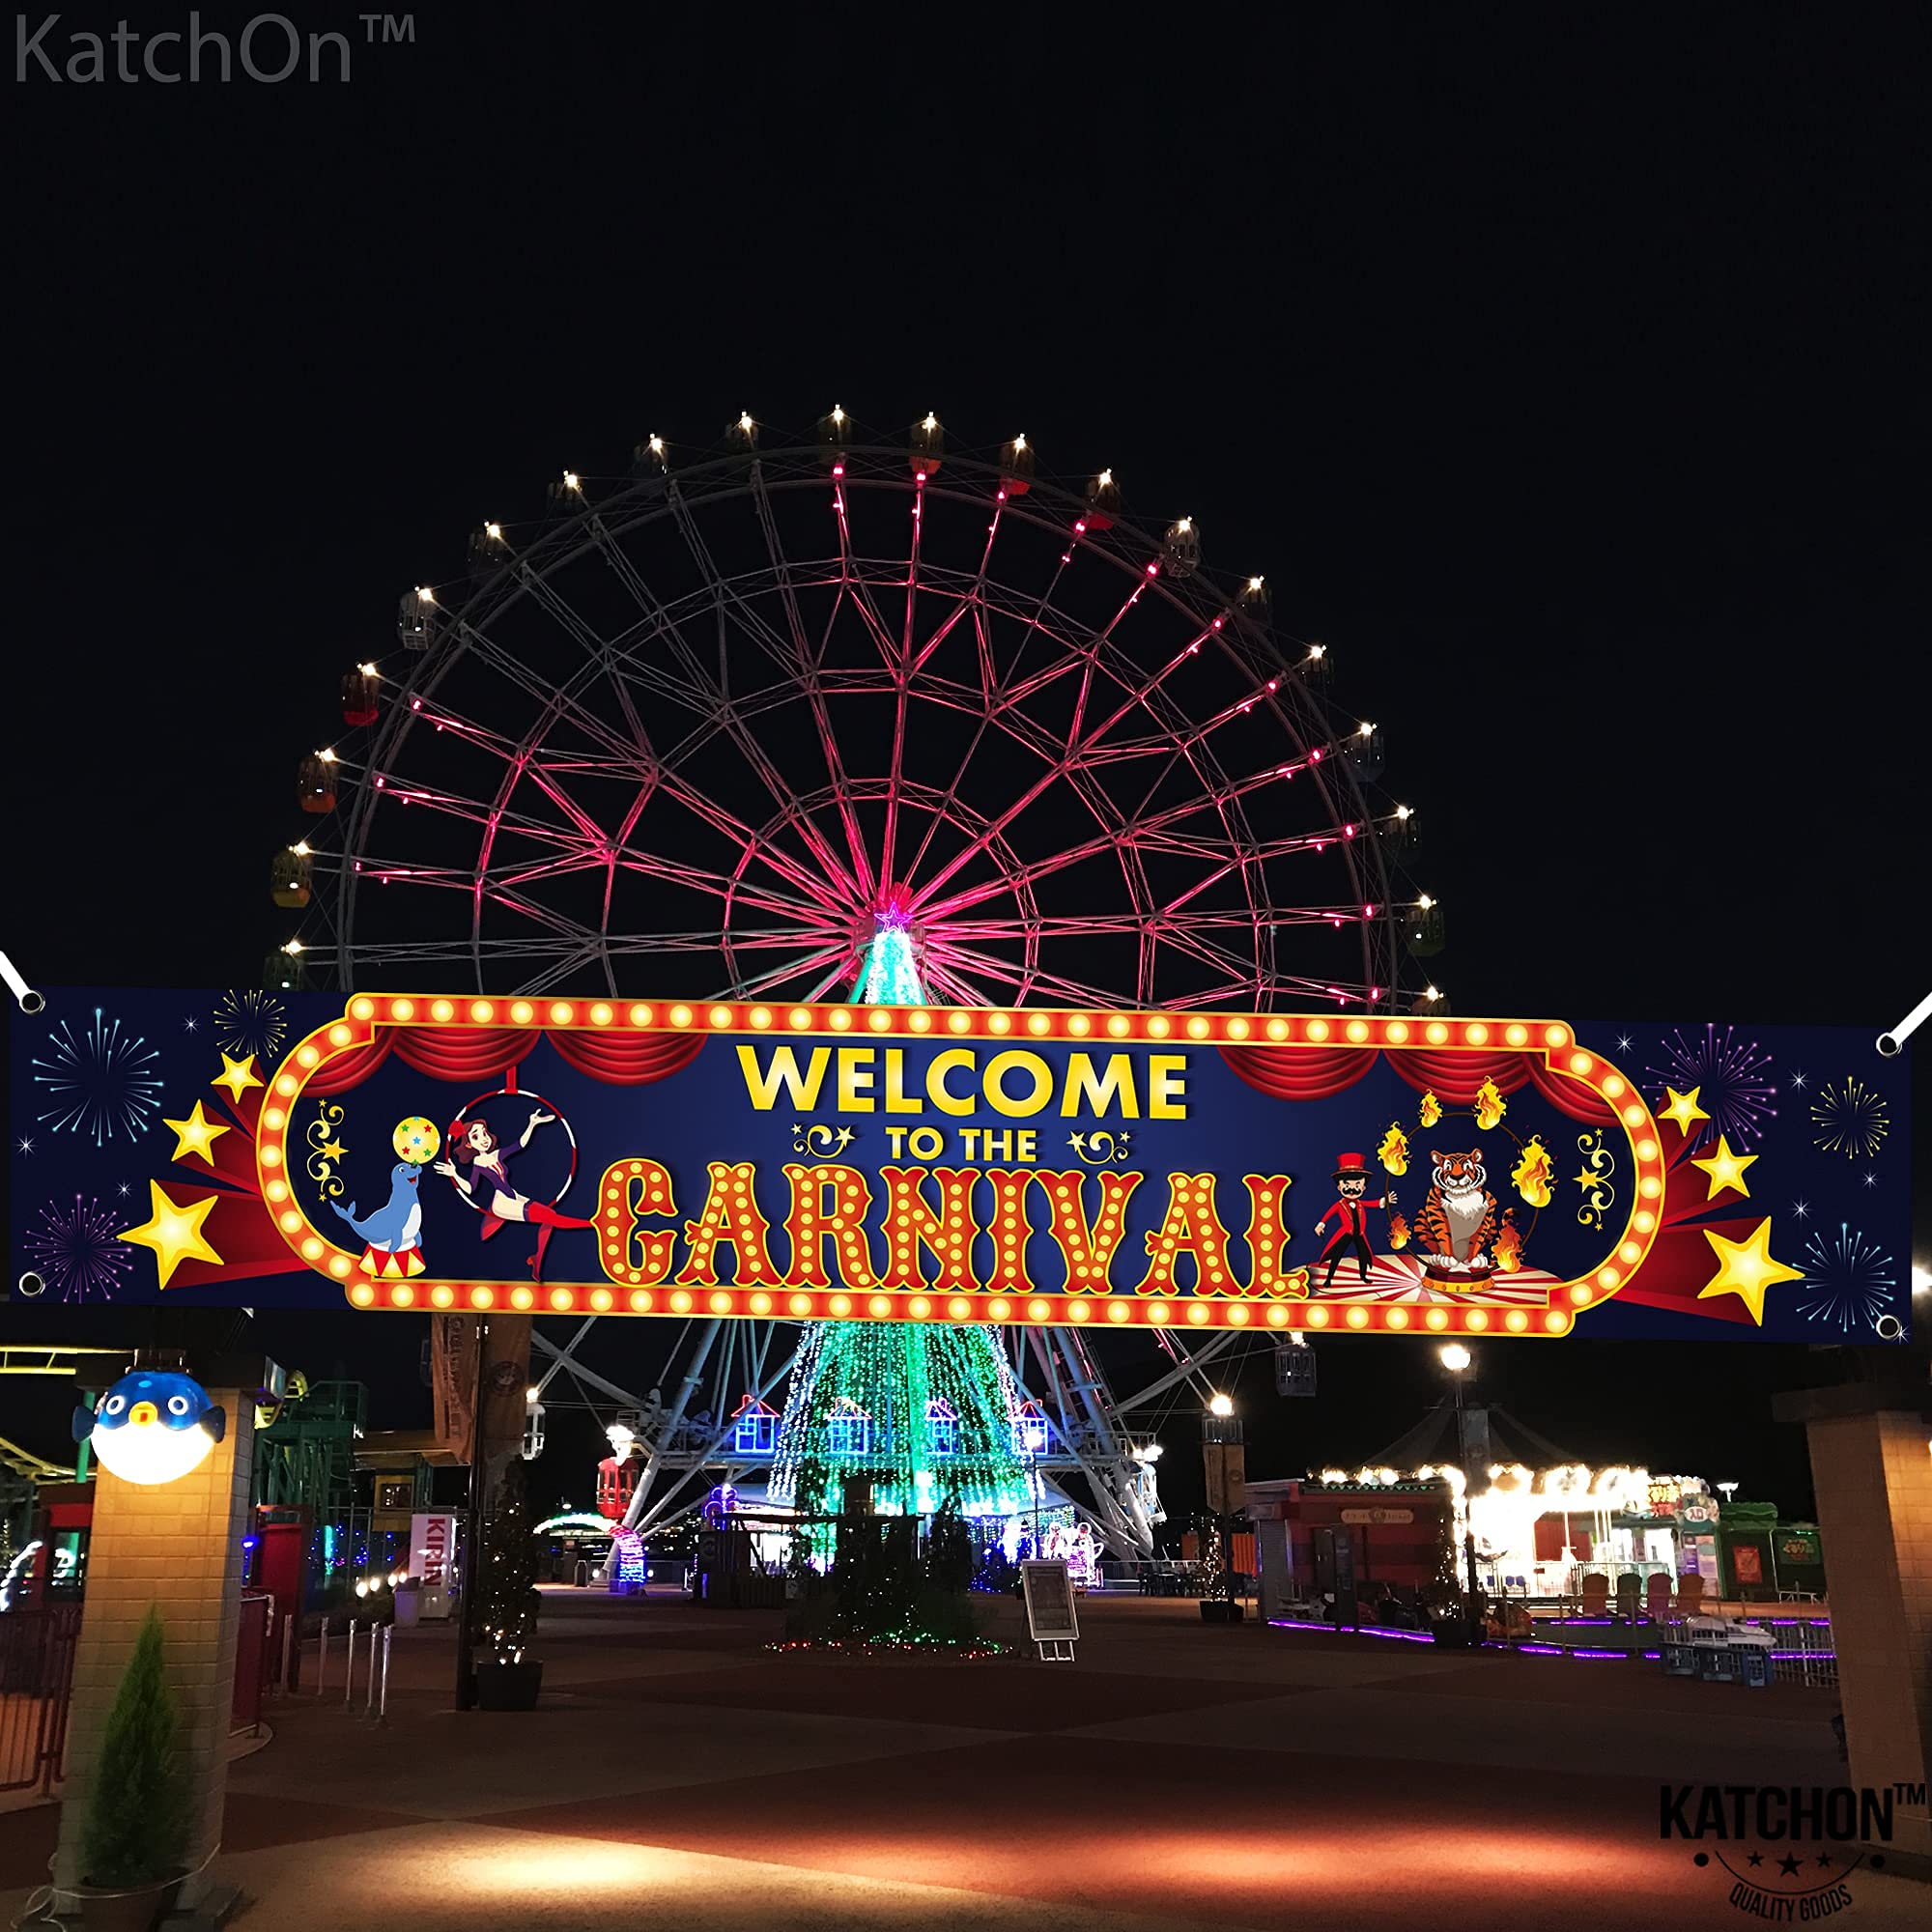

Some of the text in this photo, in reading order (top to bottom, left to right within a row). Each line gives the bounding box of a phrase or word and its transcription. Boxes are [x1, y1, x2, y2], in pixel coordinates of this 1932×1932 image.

[735, 1044, 1187, 1121] WELCOME
[886, 1125, 1037, 1162] TO THE
[589, 1157, 1310, 1300] CARNIVAL
[423, 1518, 446, 1586] KIRIN
